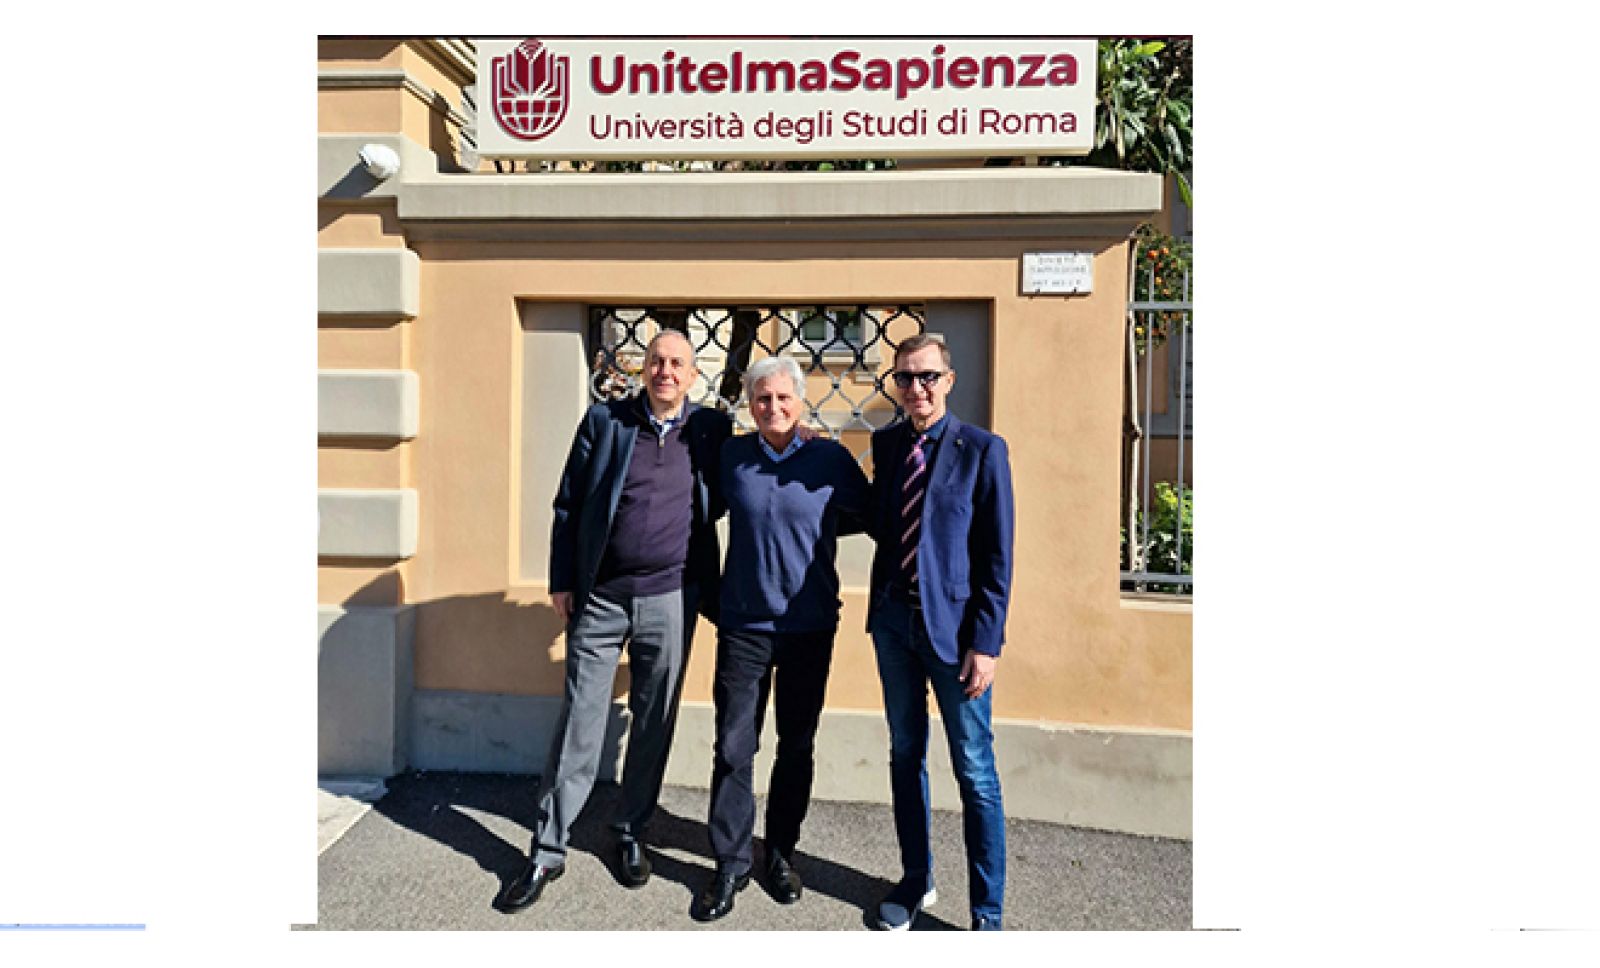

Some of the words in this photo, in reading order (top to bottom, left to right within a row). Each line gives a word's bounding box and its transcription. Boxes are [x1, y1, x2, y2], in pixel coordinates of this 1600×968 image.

[589, 44, 1078, 100] UnitelmaSapienza
[590, 111, 744, 140] Università
[753, 109, 832, 145] degli
[842, 109, 927, 138] Studi
[937, 107, 967, 136] di
[979, 109, 1077, 135] Roma
